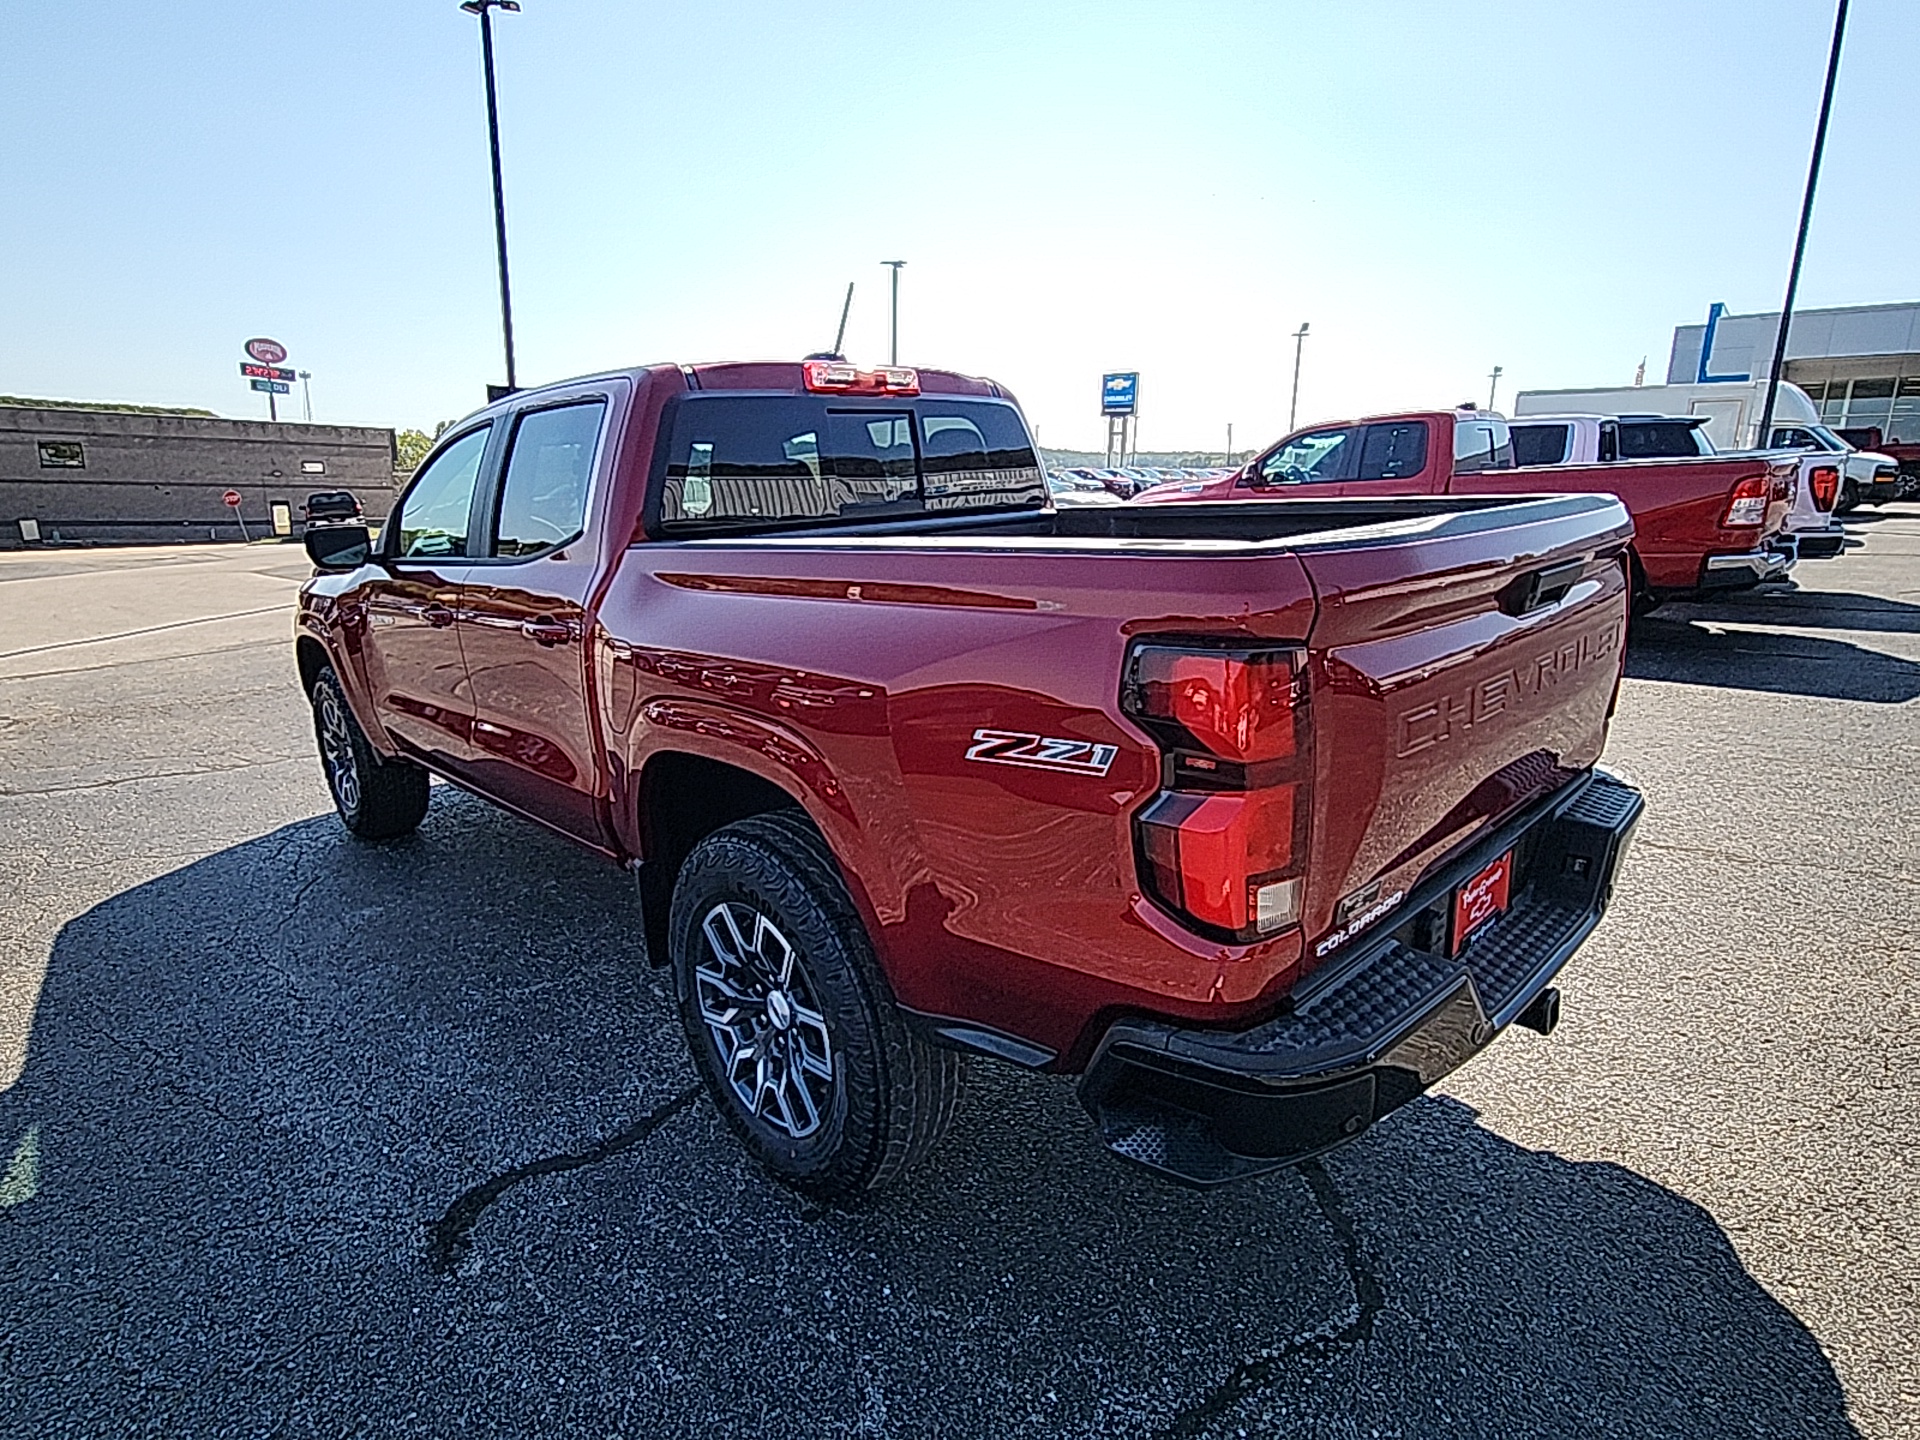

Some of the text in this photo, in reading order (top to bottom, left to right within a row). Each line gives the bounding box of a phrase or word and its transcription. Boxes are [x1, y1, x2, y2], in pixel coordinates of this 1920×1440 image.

[1397, 614, 1625, 759] CHEVROLET
[965, 729, 1119, 777] Z71
[1315, 890, 1404, 958] COLORADO
